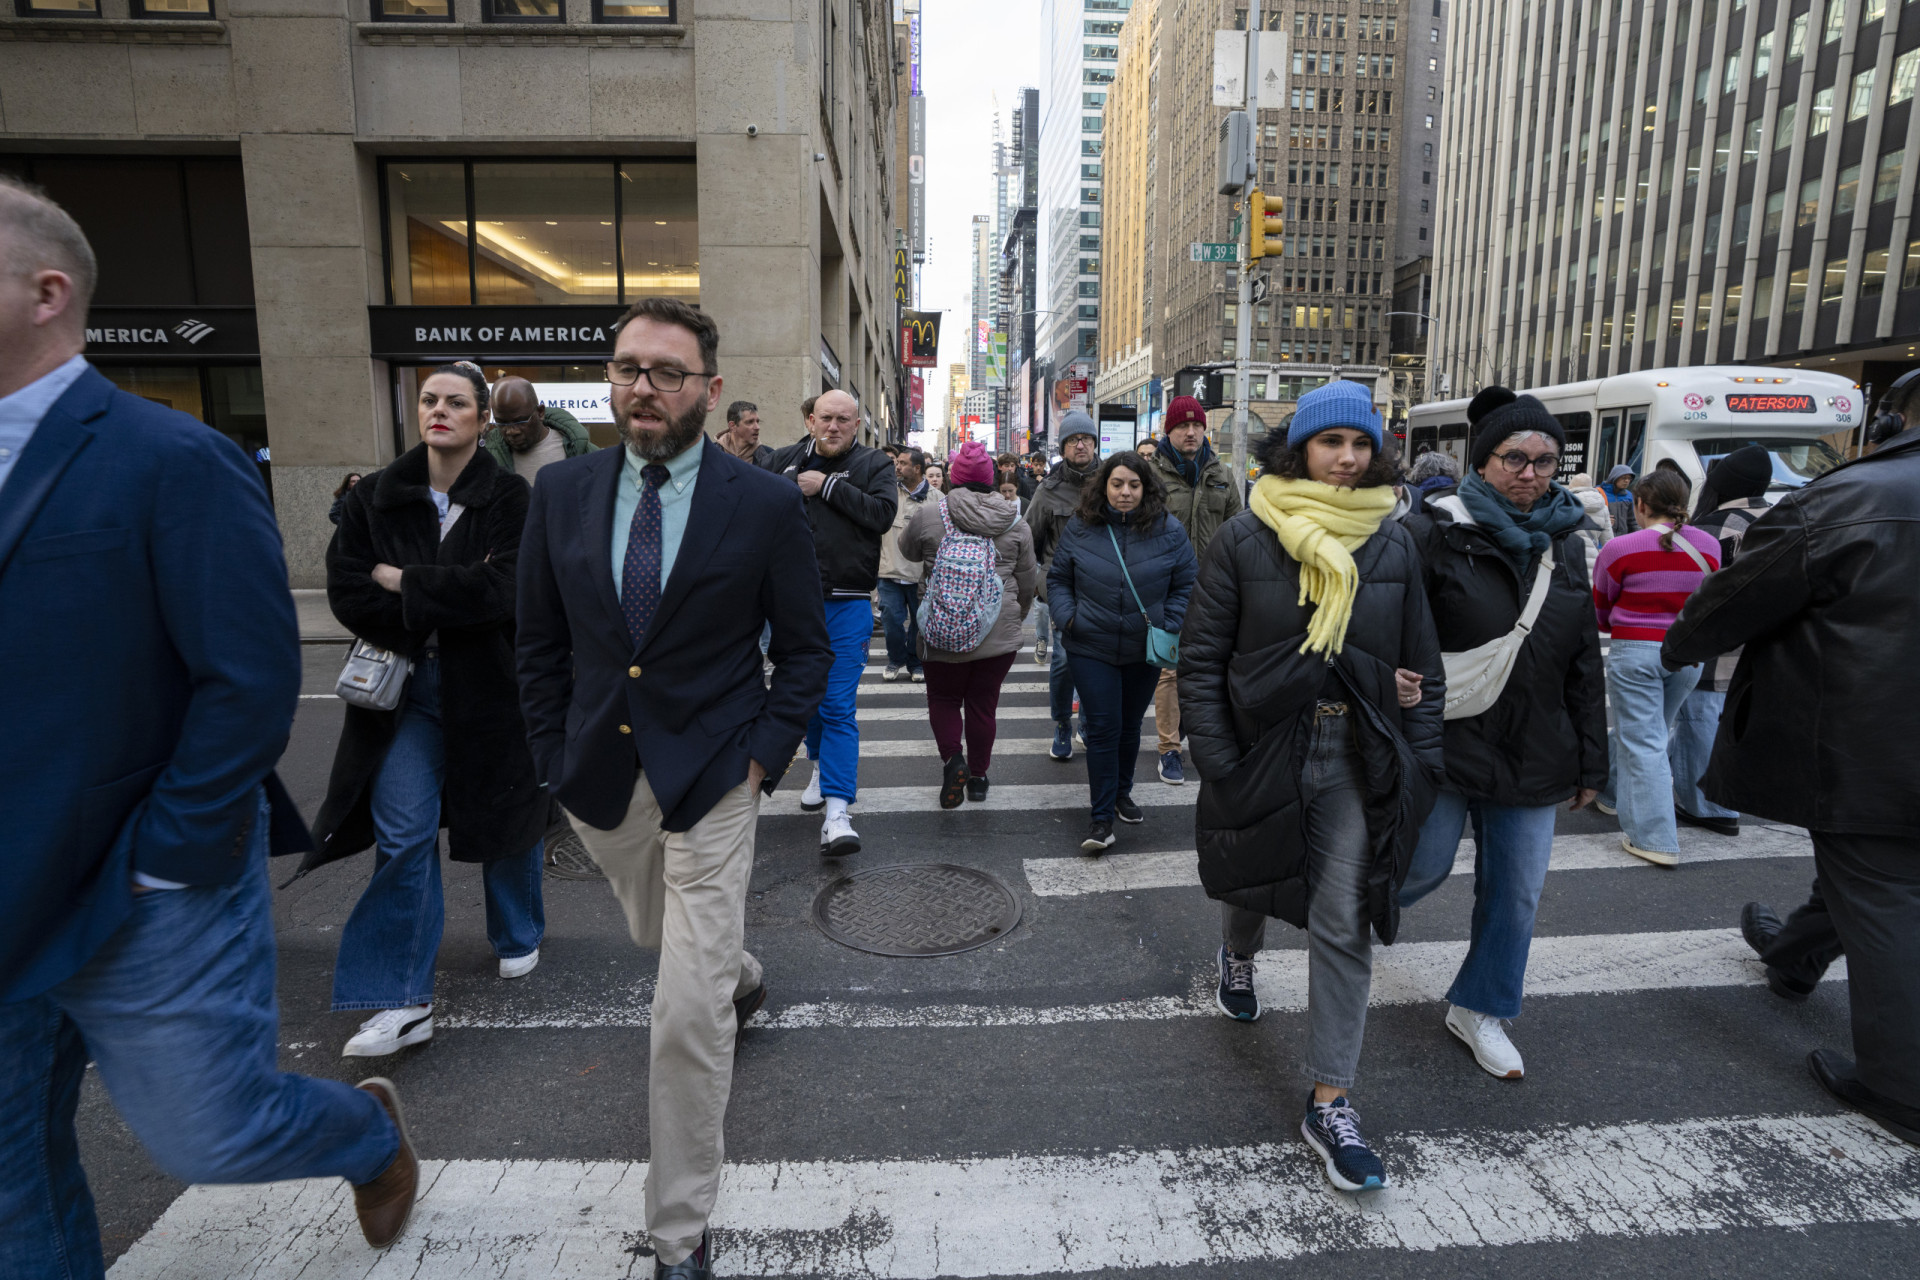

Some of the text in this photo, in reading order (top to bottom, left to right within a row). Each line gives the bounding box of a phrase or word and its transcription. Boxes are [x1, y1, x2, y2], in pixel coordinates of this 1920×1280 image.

[1203, 246, 1236, 259] W 39 St
[85, 328, 169, 343] MERICA
[415, 327, 606, 342] BANK OF AMERICA
[540, 400, 598, 409] AMERICA
[1729, 397, 1809, 410] PATERSON
[1683, 411, 1708, 421] 308
[1835, 413, 1851, 423] 308
[1564, 443, 1584, 452] RSON
[1564, 454, 1584, 463] YORK
[1563, 463, 1577, 471] AVE
